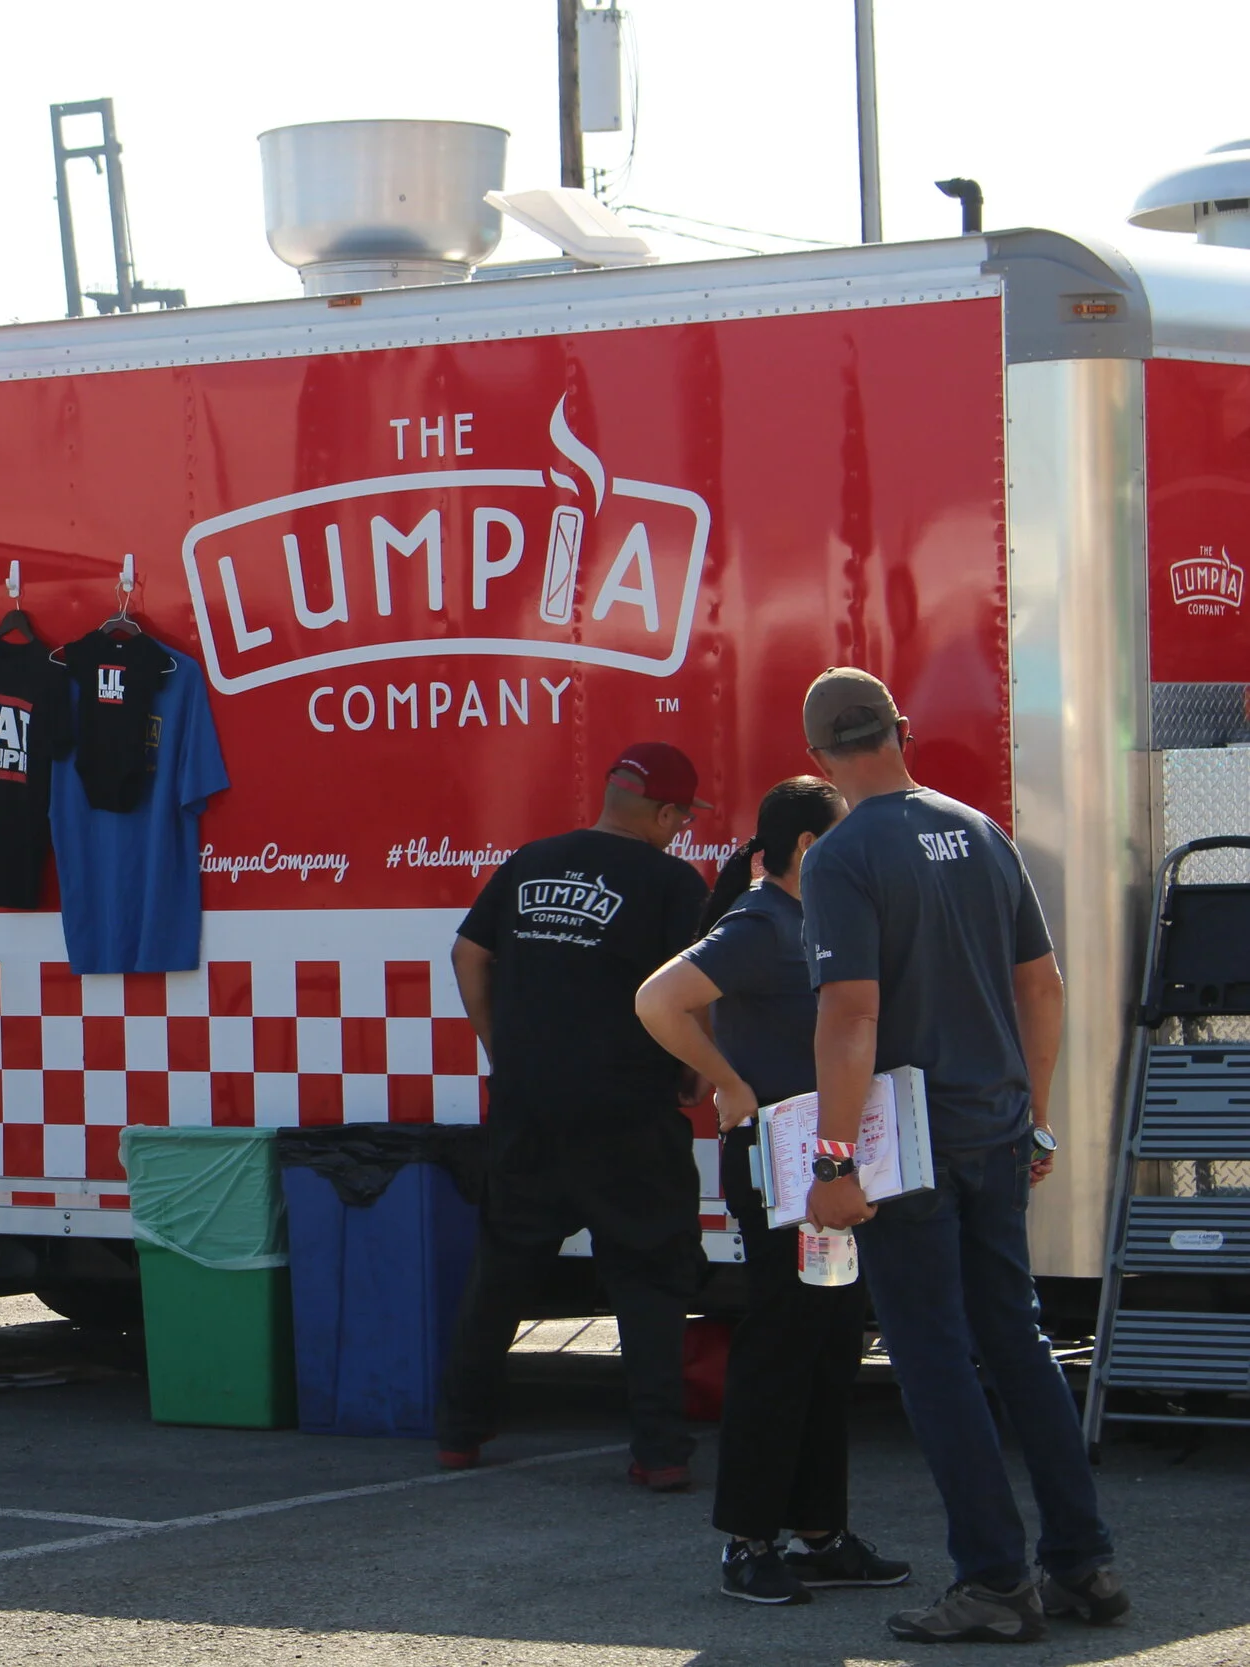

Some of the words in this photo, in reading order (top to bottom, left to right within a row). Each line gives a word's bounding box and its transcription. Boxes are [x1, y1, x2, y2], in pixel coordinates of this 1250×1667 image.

[389, 412, 474, 461] THE
[1199, 545, 1214, 557] THE
[218, 505, 660, 653] LUMPIA
[1175, 566, 1238, 599] LUMPIA
[1187, 603, 1226, 616] COMPANY
[97, 668, 126, 692] LIL
[97, 689, 124, 700] LUMPIA
[308, 676, 572, 733] COMPANY
[655, 698, 680, 713] TM
[917, 829, 970, 861] STAFF
[564, 870, 585, 881] THE
[524, 885, 610, 917] LUMPIA
[532, 912, 585, 927] COMPANY
